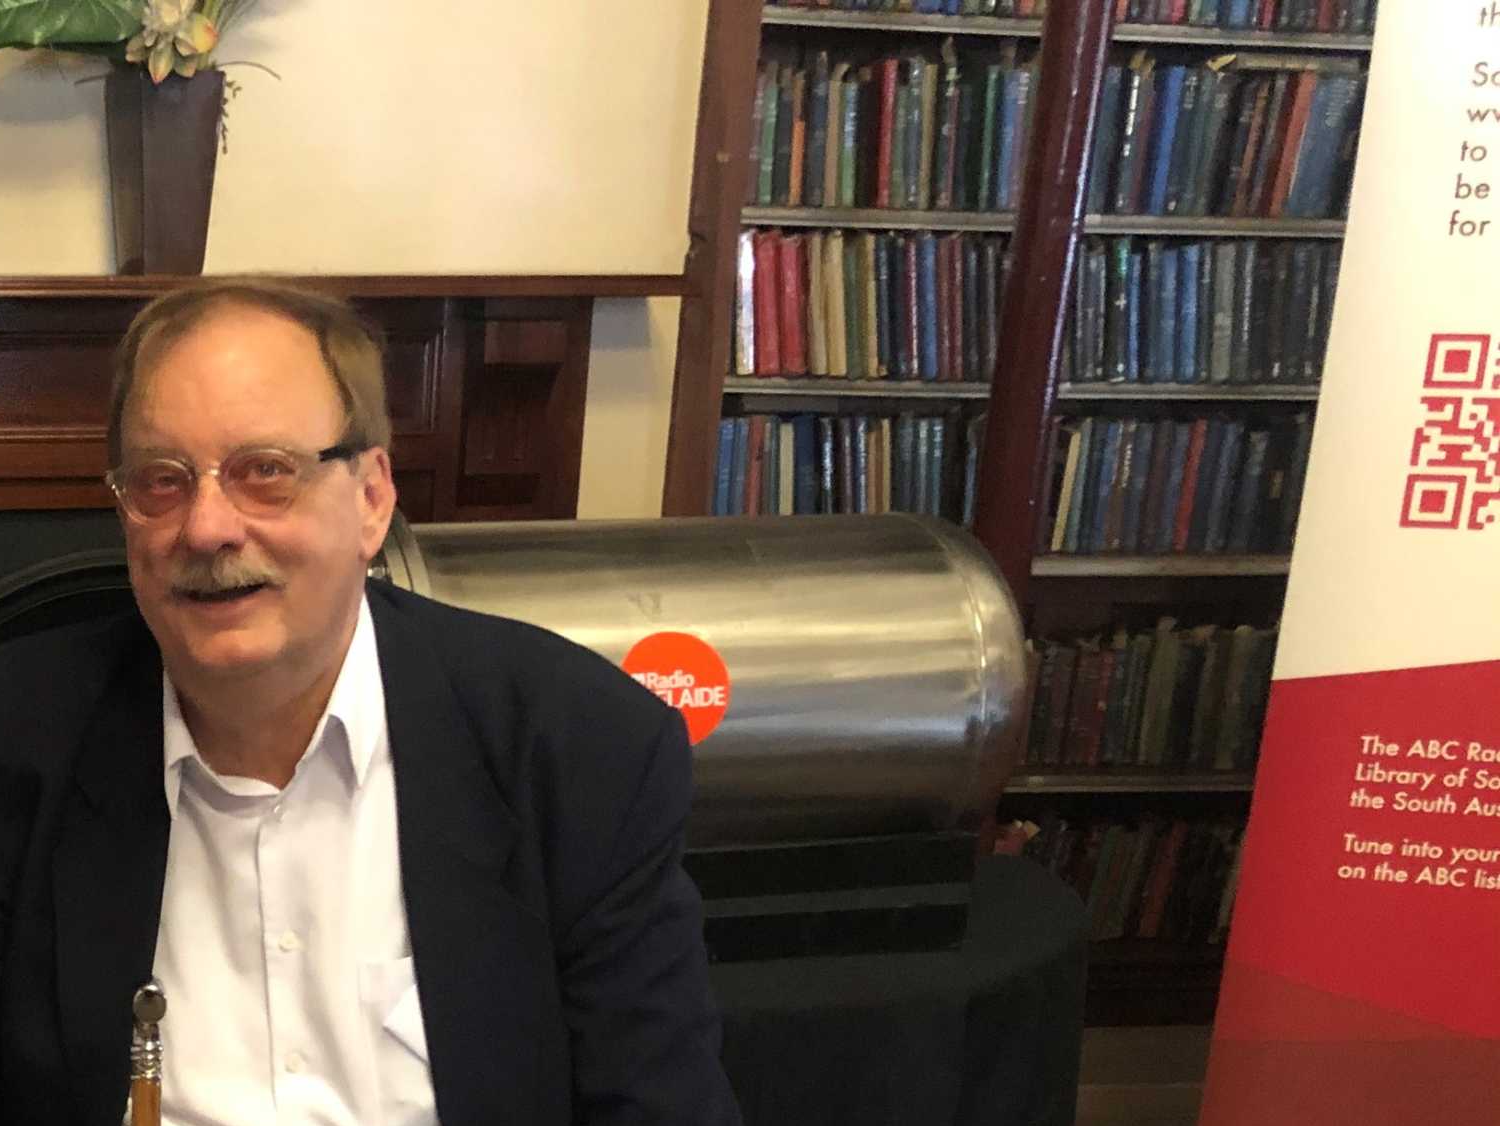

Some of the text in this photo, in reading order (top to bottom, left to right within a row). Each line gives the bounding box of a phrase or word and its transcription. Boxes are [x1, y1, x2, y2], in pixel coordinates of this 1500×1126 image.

[1460, 140, 1487, 162] to
[1454, 173, 1490, 199] be
[1448, 210, 1490, 236] for
[646, 669, 695, 689] Radio
[1360, 735, 1399, 756] The
[1407, 740, 1459, 760] ABC
[1355, 762, 1435, 791] Library
[1443, 768, 1468, 787] of
[1349, 788, 1385, 809] the
[1392, 791, 1457, 814] South
[1343, 833, 1500, 865] Tune into your
[1337, 864, 1365, 879] on
[1374, 862, 1408, 883] the
[1414, 866, 1467, 887] ABC
